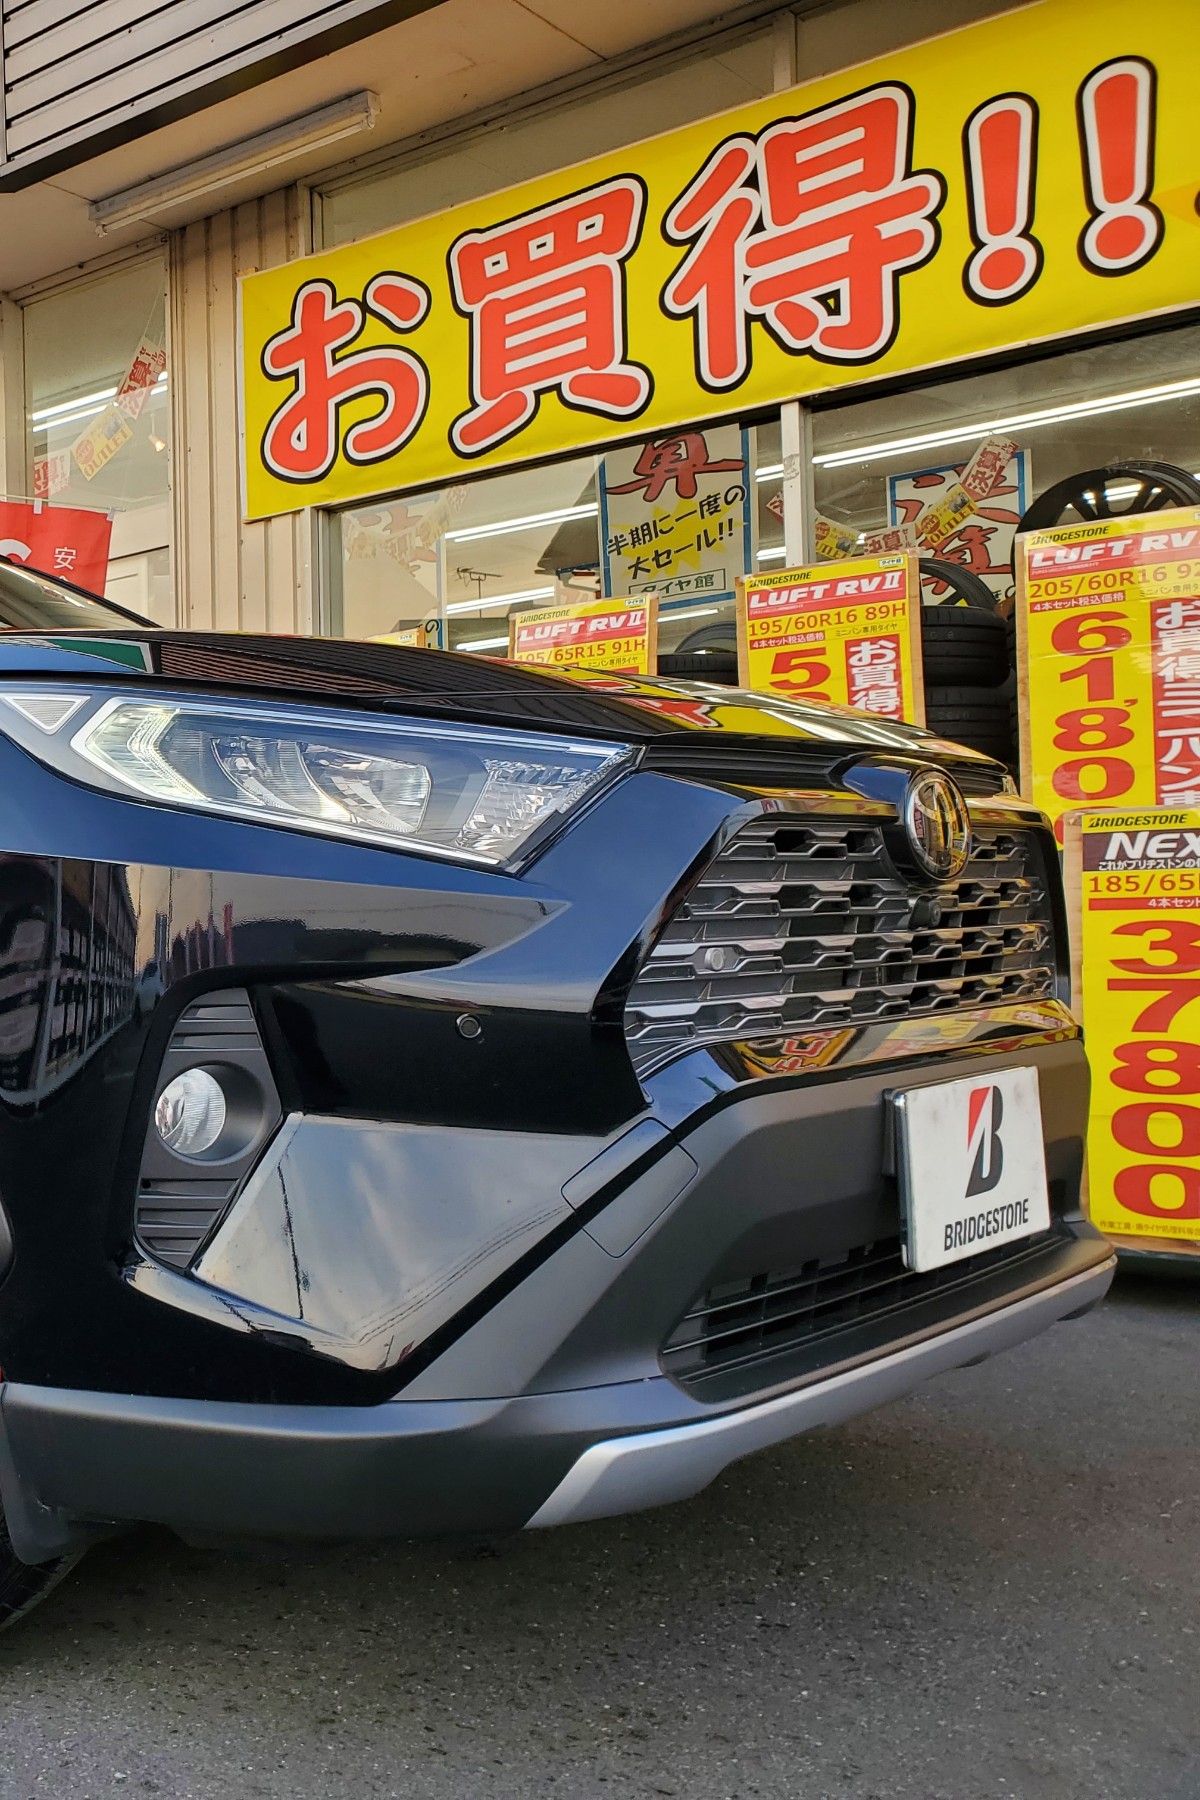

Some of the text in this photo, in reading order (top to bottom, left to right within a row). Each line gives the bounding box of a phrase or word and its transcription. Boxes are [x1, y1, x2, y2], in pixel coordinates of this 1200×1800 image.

[261, 55, 1163, 484] お買得!!
[84, 430, 128, 477] OUTLET
[966, 449, 1000, 496] 決算
[607, 485, 746, 556] 半期に一度の
[930, 504, 976, 544] OUTLET
[1031, 526, 1110, 546] BRIDGESTONE
[53, 546, 79, 582] 安
[627, 517, 734, 580] 大セール!!
[815, 543, 848, 560] UTLET
[1032, 530, 1200, 567] LUFT RV
[749, 572, 812, 588] BRIDGESTONE
[750, 584, 830, 608] LUFT
[1029, 566, 1168, 599] 205/60R16
[519, 609, 570, 624] BRIDGESTONE
[1033, 591, 1125, 611] 4本セット税込価格
[519, 620, 585, 642] LUFT
[749, 603, 906, 636] 195/60R16 89H
[835, 623, 898, 637] ミニバン専用タイヤ
[517, 639, 646, 663] 195/65R15 91H
[752, 632, 825, 649] 4本セット税込価格
[588, 656, 638, 669] ミニバン専用タイヤ
[769, 647, 831, 701] 5
[848, 639, 900, 721] お買得
[1052, 611, 1139, 840] 61,80
[1088, 813, 1189, 829] BRIDGESTONE
[1089, 873, 1200, 895] 185/65
[943, 1198, 1029, 1252] BRIDGESTONE
